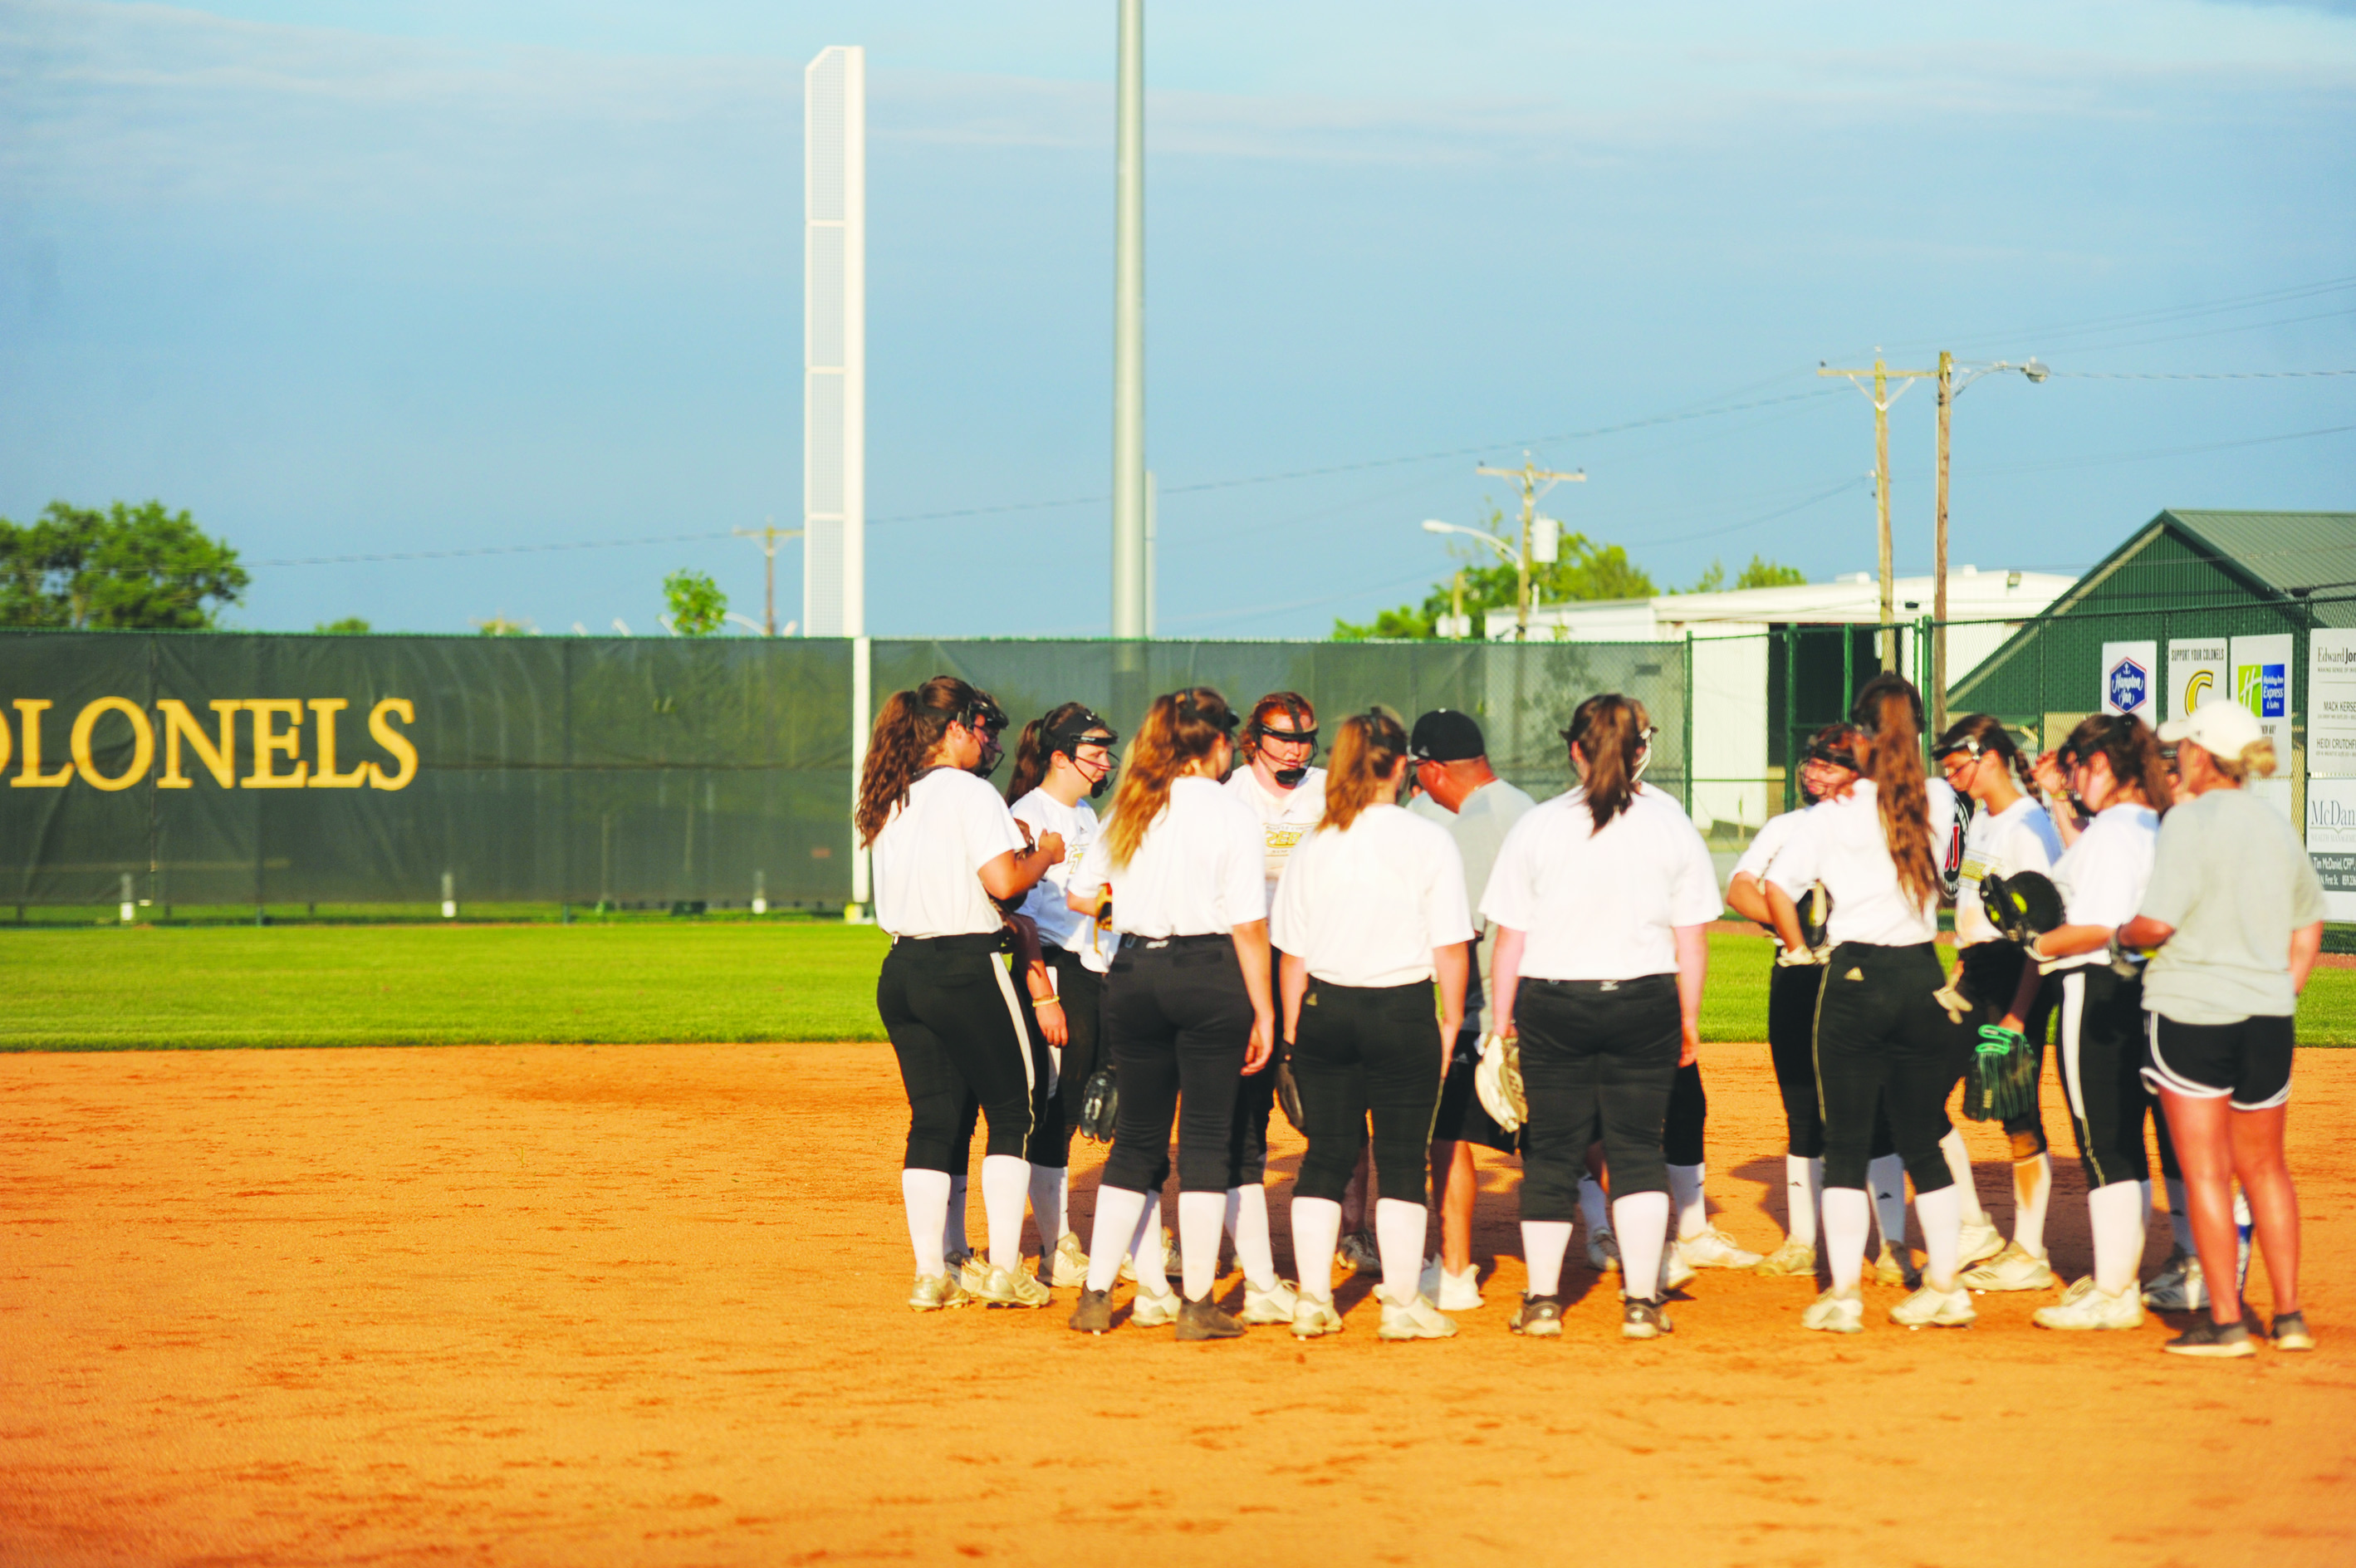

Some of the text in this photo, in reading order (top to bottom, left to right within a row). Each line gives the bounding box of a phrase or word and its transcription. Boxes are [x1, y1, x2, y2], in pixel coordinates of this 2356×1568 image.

[2172, 648, 2224, 662] SUPPORT YOUR COLONELS
[2318, 647, 2344, 663] Edward
[2112, 673, 2143, 693] Hampton
[2118, 689, 2134, 708] Inn
[2263, 685, 2284, 700] Express
[2324, 702, 2338, 712] MACK
[0, 696, 419, 791] LONELS
[2317, 738, 2330, 749] HEIDI
[2312, 800, 2355, 826] McDan
[2313, 857, 2322, 870] Tim
